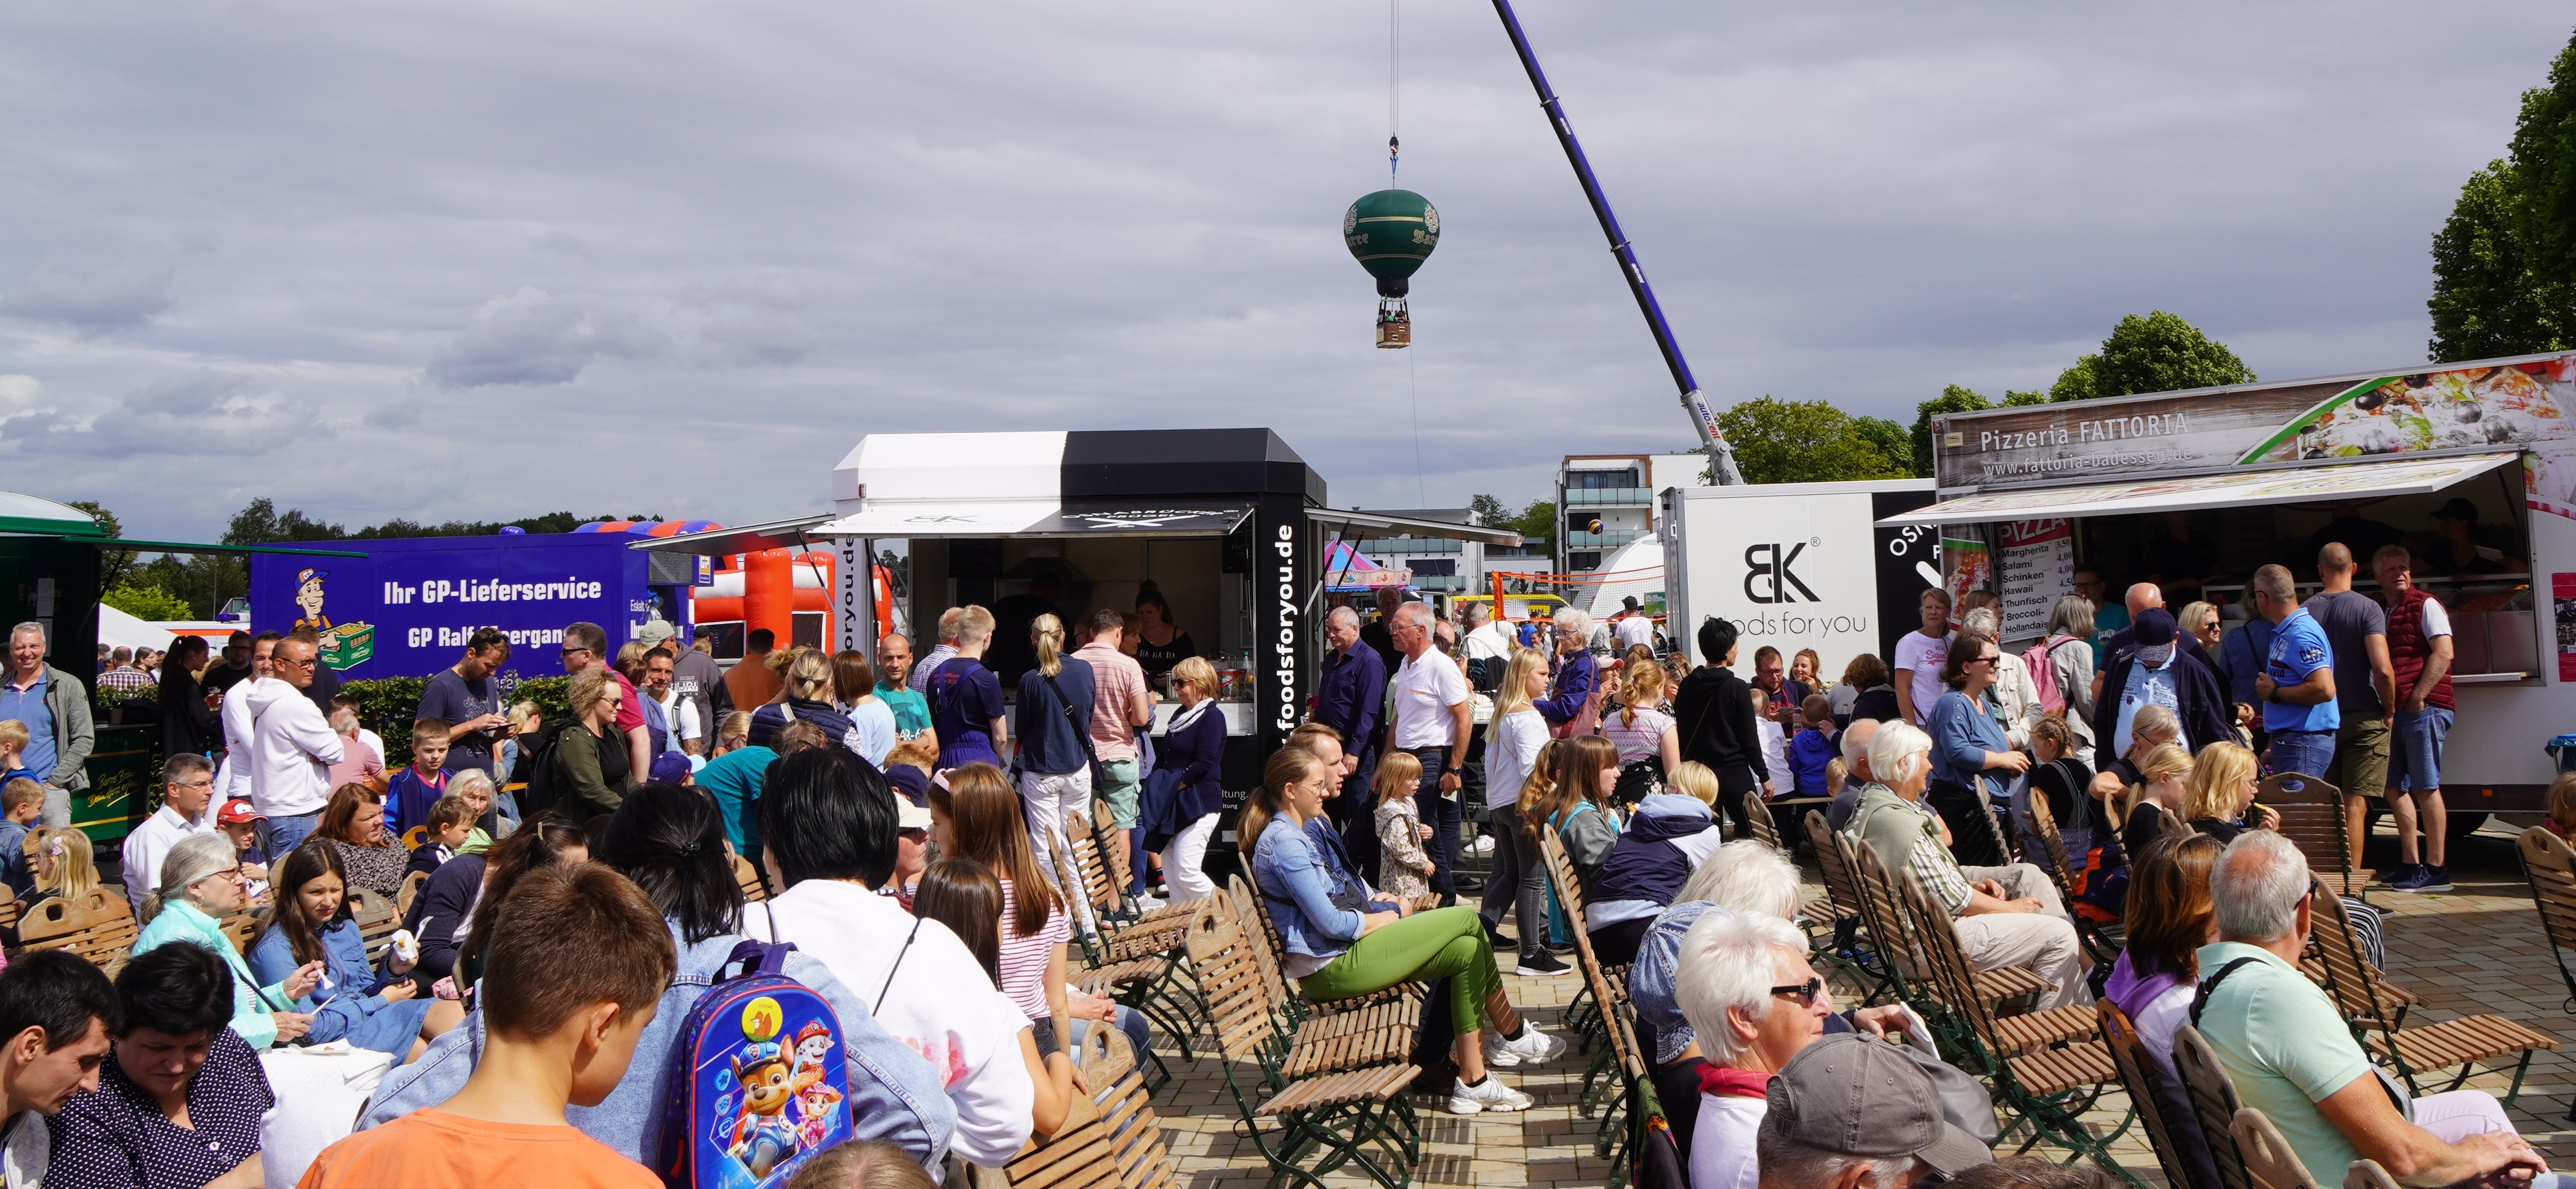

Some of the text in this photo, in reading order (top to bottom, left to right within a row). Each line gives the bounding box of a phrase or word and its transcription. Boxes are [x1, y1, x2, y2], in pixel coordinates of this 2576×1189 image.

[1981, 412, 2189, 451] Pizzeria FATTORIA
[1983, 446, 2192, 476] www.fattoria-badessen.de
[1998, 518, 2067, 546] PIZZA
[2002, 544, 2049, 558] Margherita
[2002, 560, 2033, 571] Salami
[2003, 571, 2044, 583] Schinken
[384, 576, 601, 604] Ihr GP-Lieferservice
[2004, 584, 2033, 596] Hawaii
[2005, 595, 2048, 609] Thunfisch
[2007, 609, 2044, 621] Broccoli-
[1782, 611, 1814, 634] for
[1820, 616, 1866, 638] you
[408, 627, 432, 647] GP
[1222, 789, 1248, 800] ltung.
